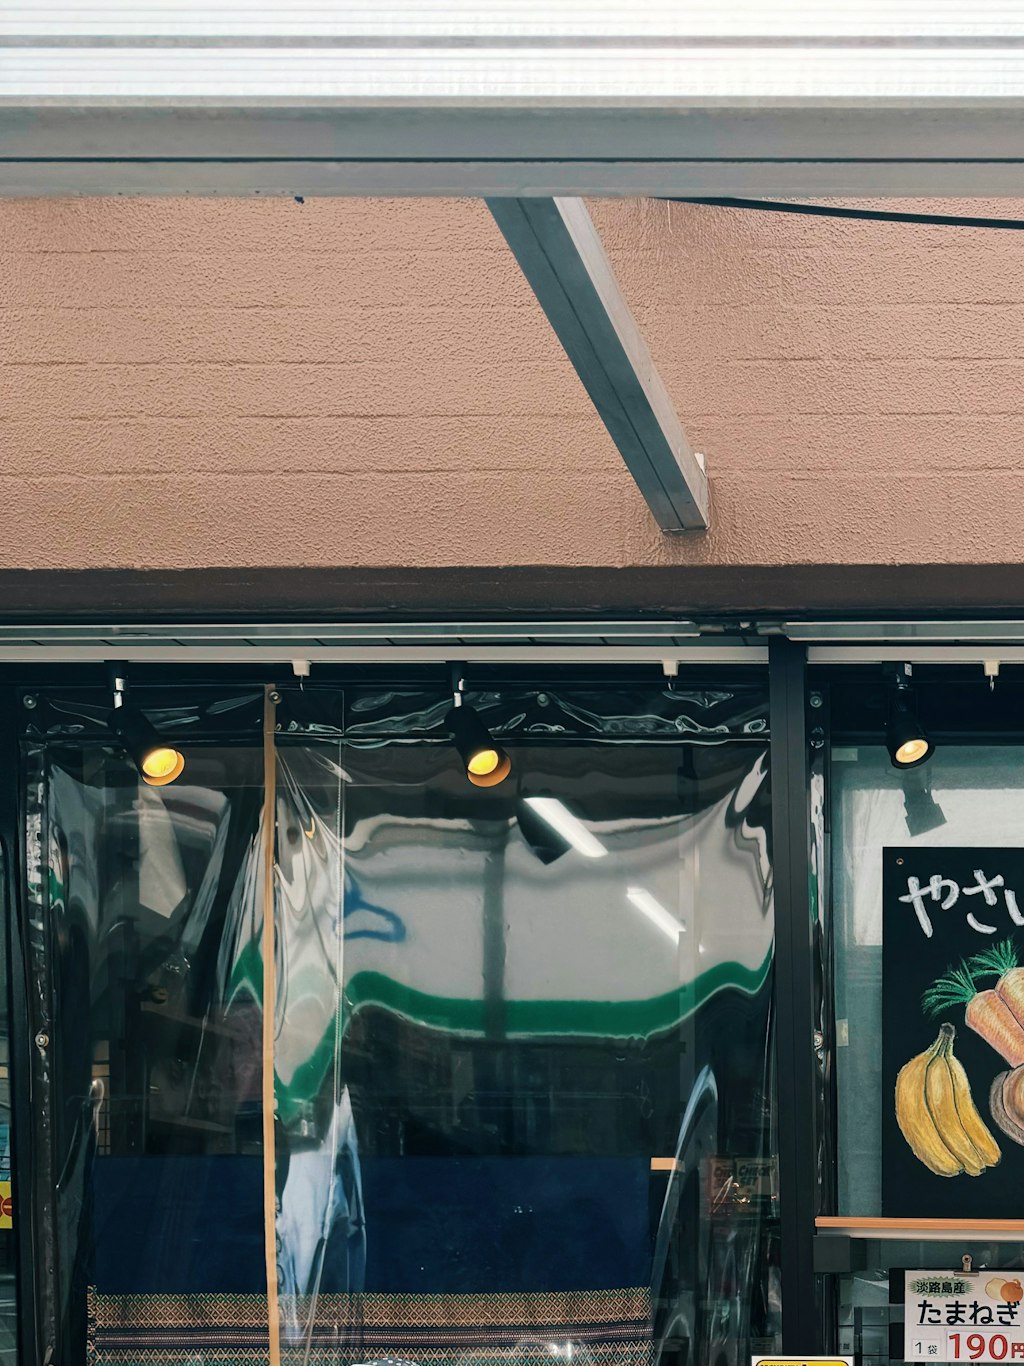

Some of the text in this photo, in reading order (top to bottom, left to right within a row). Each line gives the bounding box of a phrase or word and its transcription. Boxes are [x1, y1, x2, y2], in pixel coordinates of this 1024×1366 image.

[916, 1281, 966, 1294] 淡路島産
[917, 1299, 1020, 1326] たまねぎ
